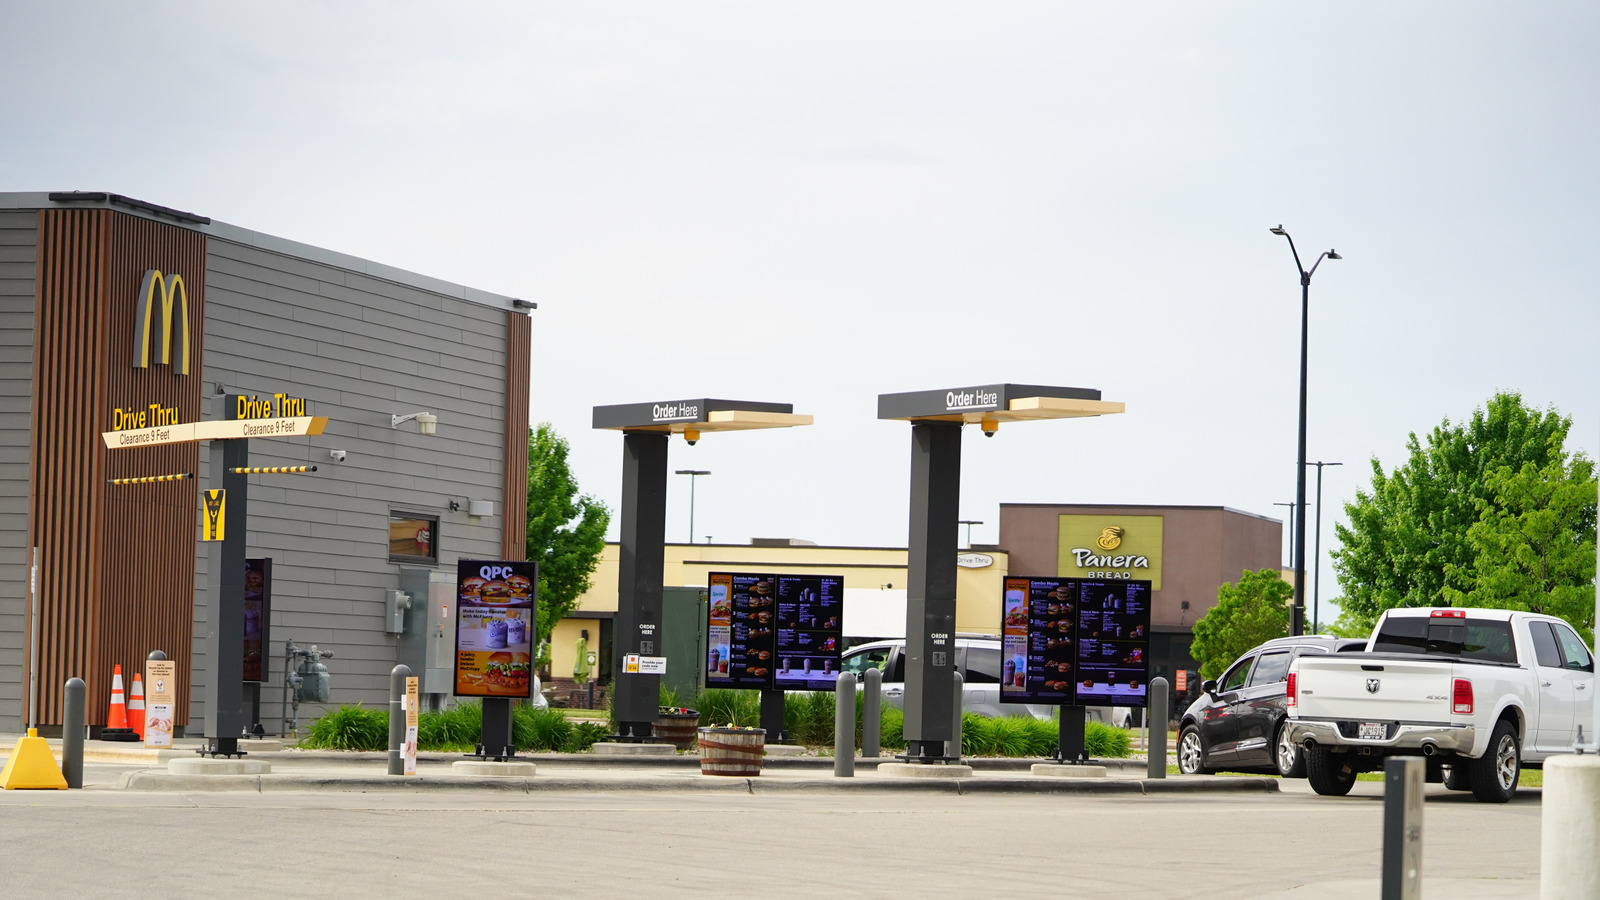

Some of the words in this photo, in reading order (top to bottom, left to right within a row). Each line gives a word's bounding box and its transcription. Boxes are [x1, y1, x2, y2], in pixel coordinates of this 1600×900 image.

[238, 395, 271, 419] Drive
[275, 393, 305, 417] Thru
[946, 391, 974, 406] Order
[976, 390, 997, 404] Here
[114, 408, 146, 430] Drive
[150, 404, 179, 425] Thru
[653, 404, 677, 418] Order
[679, 403, 697, 416] Here
[243, 423, 274, 436] Clearance
[276, 422, 279, 433] 9
[281, 420, 295, 432] Feet
[119, 431, 150, 446] Clearance
[151, 430, 154, 441] 9
[156, 429, 170, 440] Feet
[1072, 548, 1148, 568] Panera
[480, 566, 513, 581] QPC
